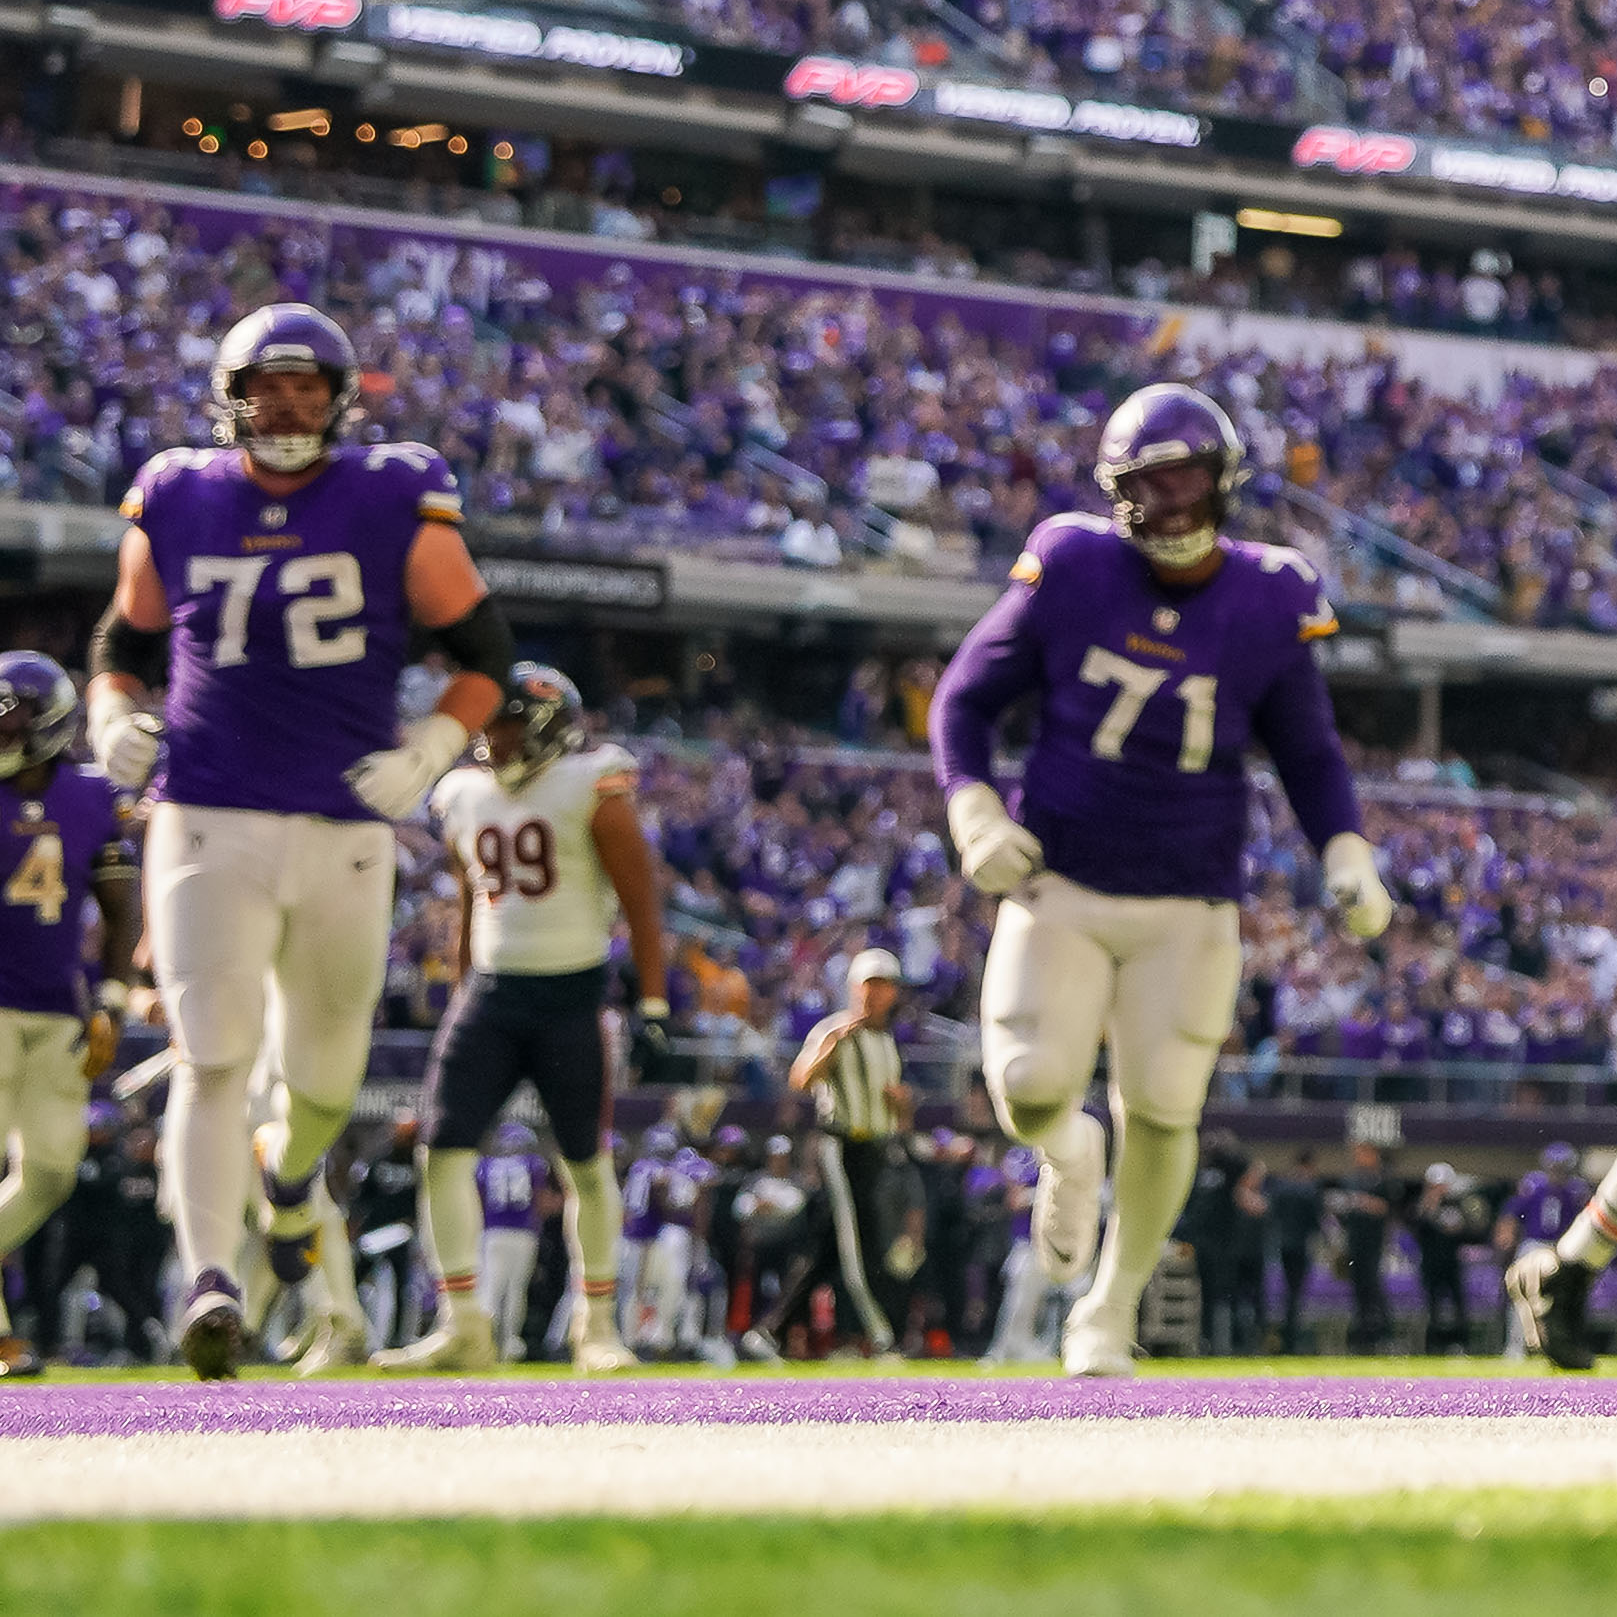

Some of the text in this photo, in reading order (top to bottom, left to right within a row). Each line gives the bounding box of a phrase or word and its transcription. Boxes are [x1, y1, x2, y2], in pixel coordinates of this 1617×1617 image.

[186, 551, 369, 669] 72
[1078, 645, 1219, 775] 71
[4, 835, 68, 926] 4
[475, 817, 556, 901] 99
